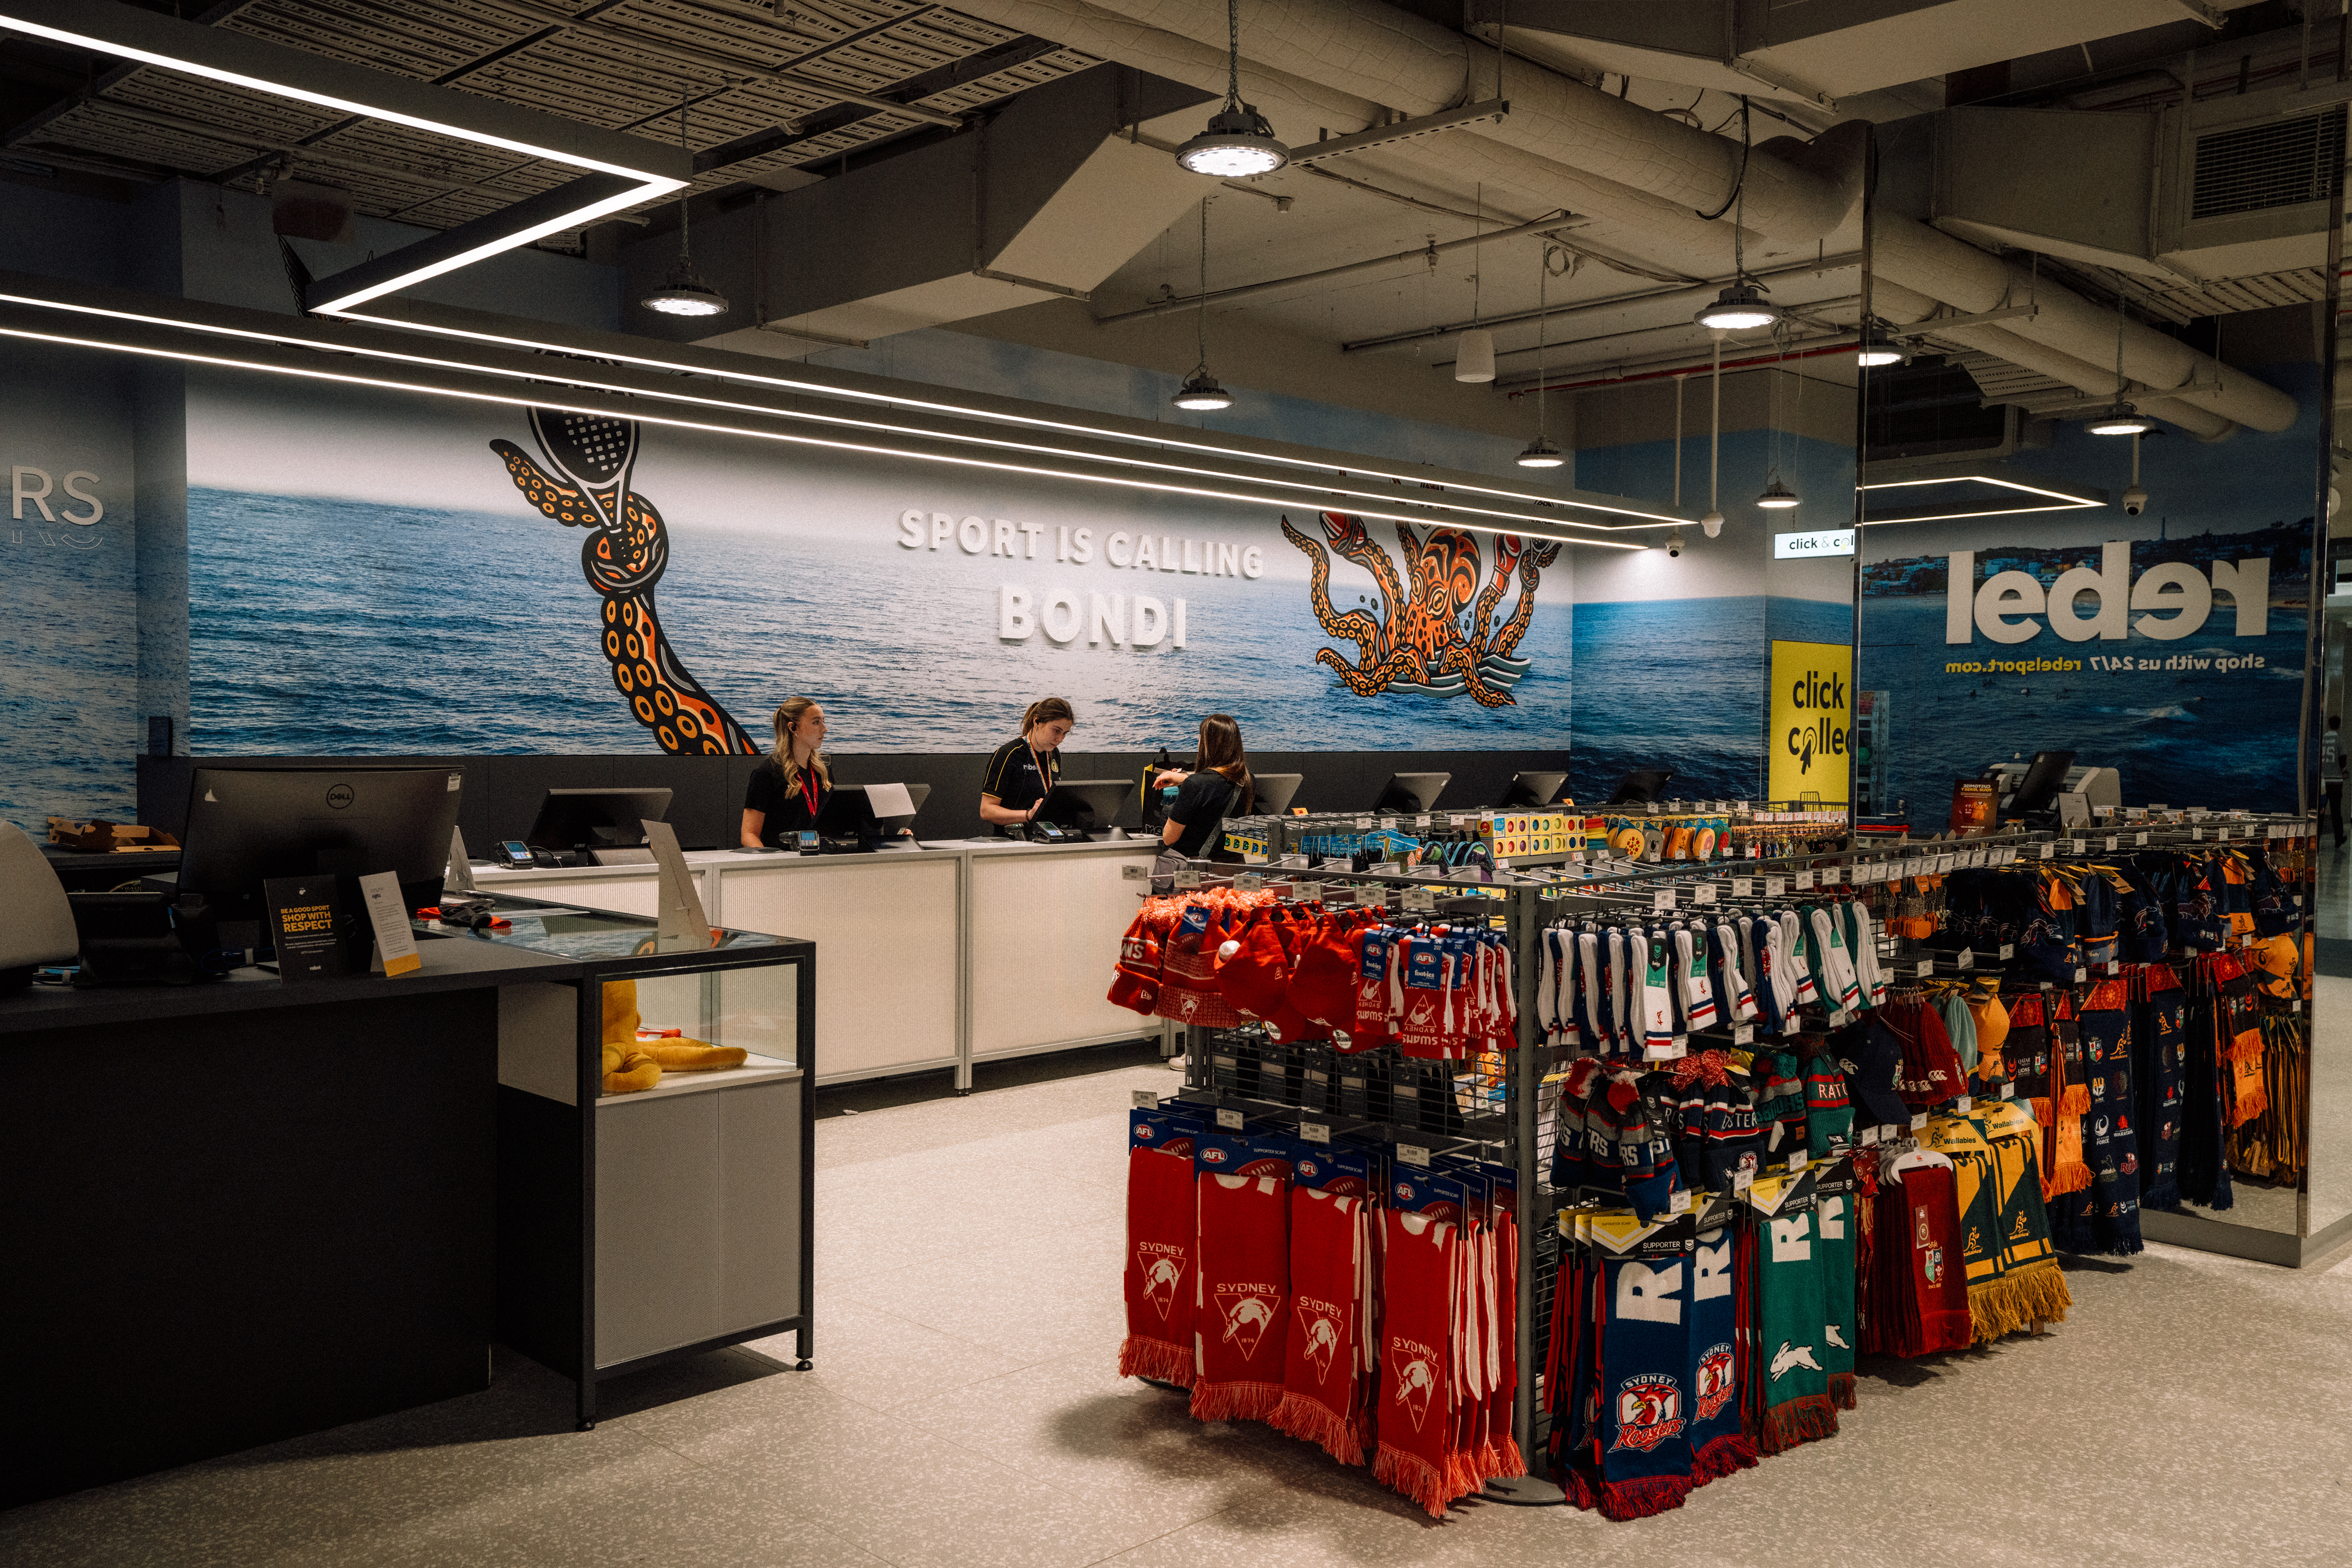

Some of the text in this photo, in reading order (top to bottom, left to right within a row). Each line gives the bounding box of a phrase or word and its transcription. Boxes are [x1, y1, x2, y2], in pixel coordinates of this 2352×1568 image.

[12, 465, 103, 525] RS
[898, 509, 1263, 578] SPORT IS CALLING
[1789, 537, 1818, 550] click
[1822, 536, 1830, 548] &
[1000, 584, 1187, 647] BONDI
[1793, 671, 1845, 710] click
[282, 911, 331, 922] SHOP WITH
[283, 919, 332, 932] RESPECT
[1367, 946, 1381, 954] AFL
[1357, 1010, 1382, 1022] SWANS
[1402, 1034, 1438, 1045] SWANS
[2093, 1077, 2104, 1087] AU
[2093, 1086, 2104, 1096] NZ
[1993, 1118, 2024, 1129] Wallabies
[1135, 1126, 1152, 1136] AFL
[1943, 1137, 1976, 1145] Wallabies
[1203, 1151, 1225, 1161] AFL
[1300, 1163, 1316, 1176] AFL
[1337, 1164, 1352, 1172] SUPPORTER
[2120, 1161, 2137, 1174] REDS
[1397, 1185, 1412, 1198] AFL
[1434, 1188, 1449, 1196] SUPPORTER
[1785, 1196, 1808, 1208] SUPPORTER
[1703, 1212, 1725, 1223] SUPPORTER
[2010, 1232, 2029, 1240] Wallabies
[1140, 1242, 1184, 1256] SYDNEY
[1217, 1283, 1277, 1293] SYDNEY
[1394, 1337, 1438, 1362] SYDNEY
[1701, 1345, 1730, 1363] SYDNEY
[1625, 1375, 1673, 1388] SYDNEY
[1695, 1383, 1734, 1419] Roosters
[1413, 1404, 1424, 1413] 1874
[1614, 1419, 1683, 1449] Roosters
